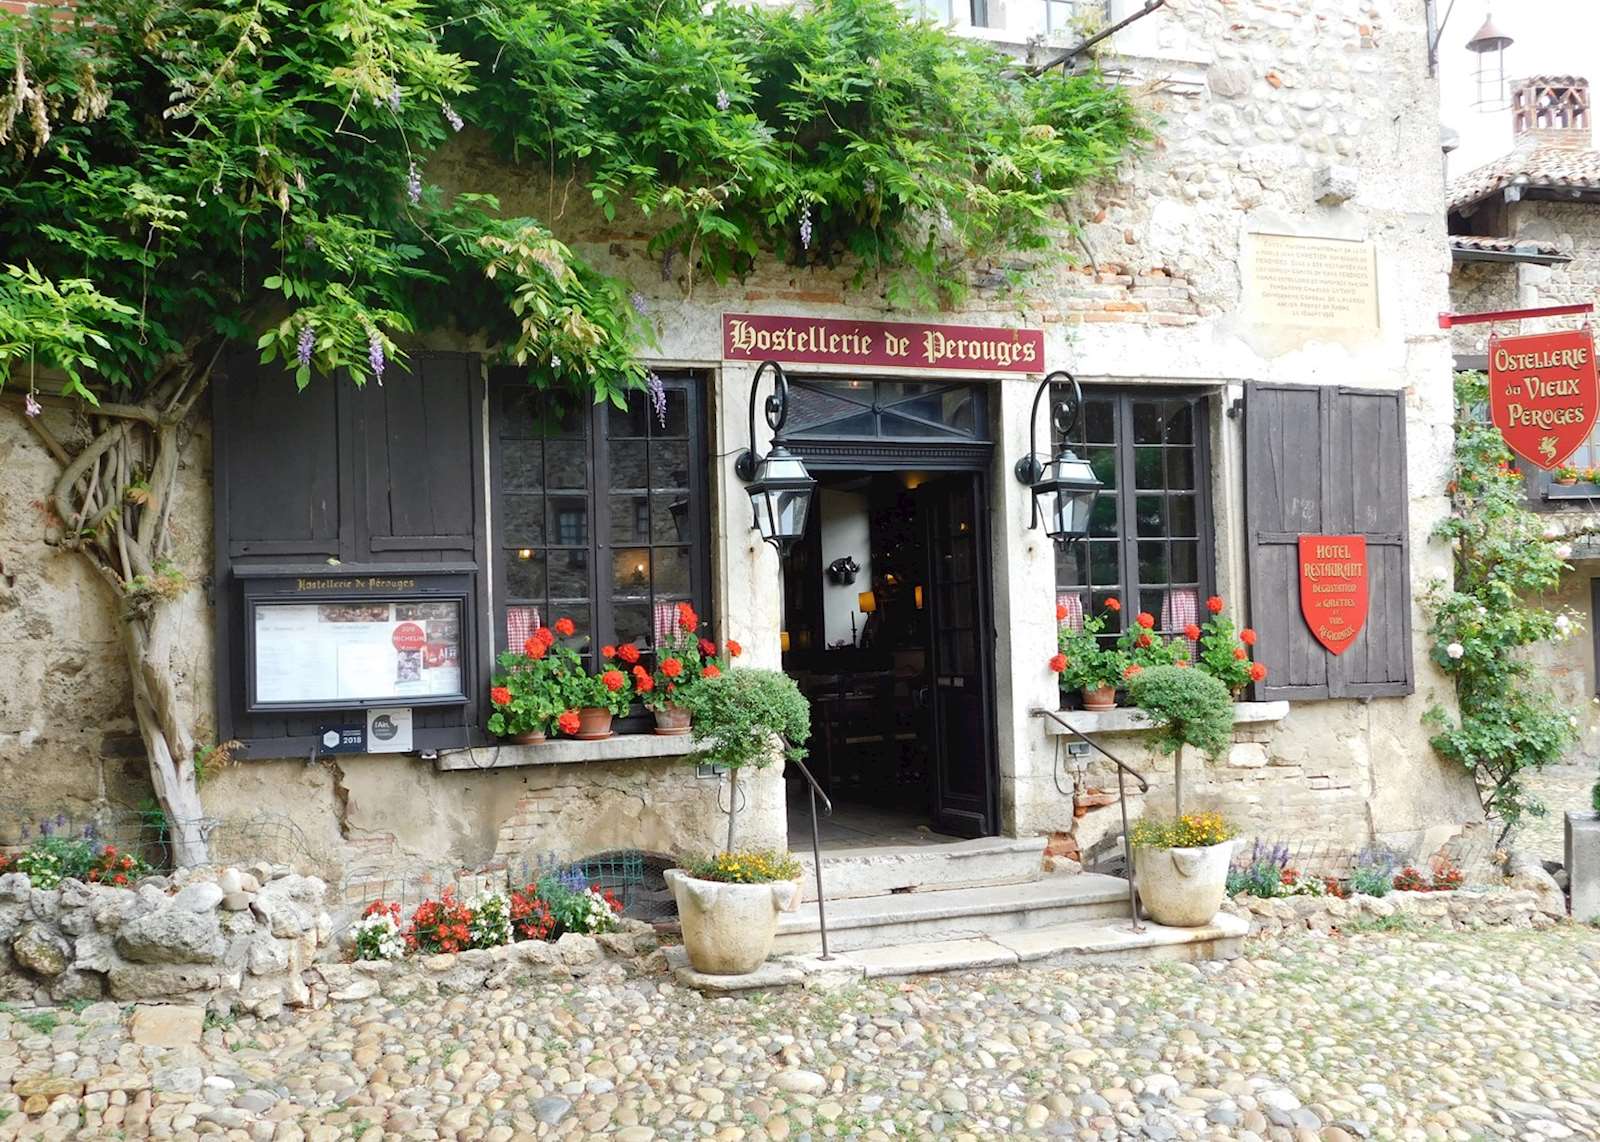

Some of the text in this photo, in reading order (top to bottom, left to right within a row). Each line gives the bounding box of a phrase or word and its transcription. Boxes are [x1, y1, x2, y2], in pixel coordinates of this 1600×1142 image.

[729, 319, 1037, 366] Hostellerie de Perouges
[1495, 347, 1588, 372] OSTELLERIE
[1505, 376, 1580, 400] du VIEUX
[1316, 545, 1351, 559] HOTEL
[1304, 563, 1363, 581] RESTAURANT
